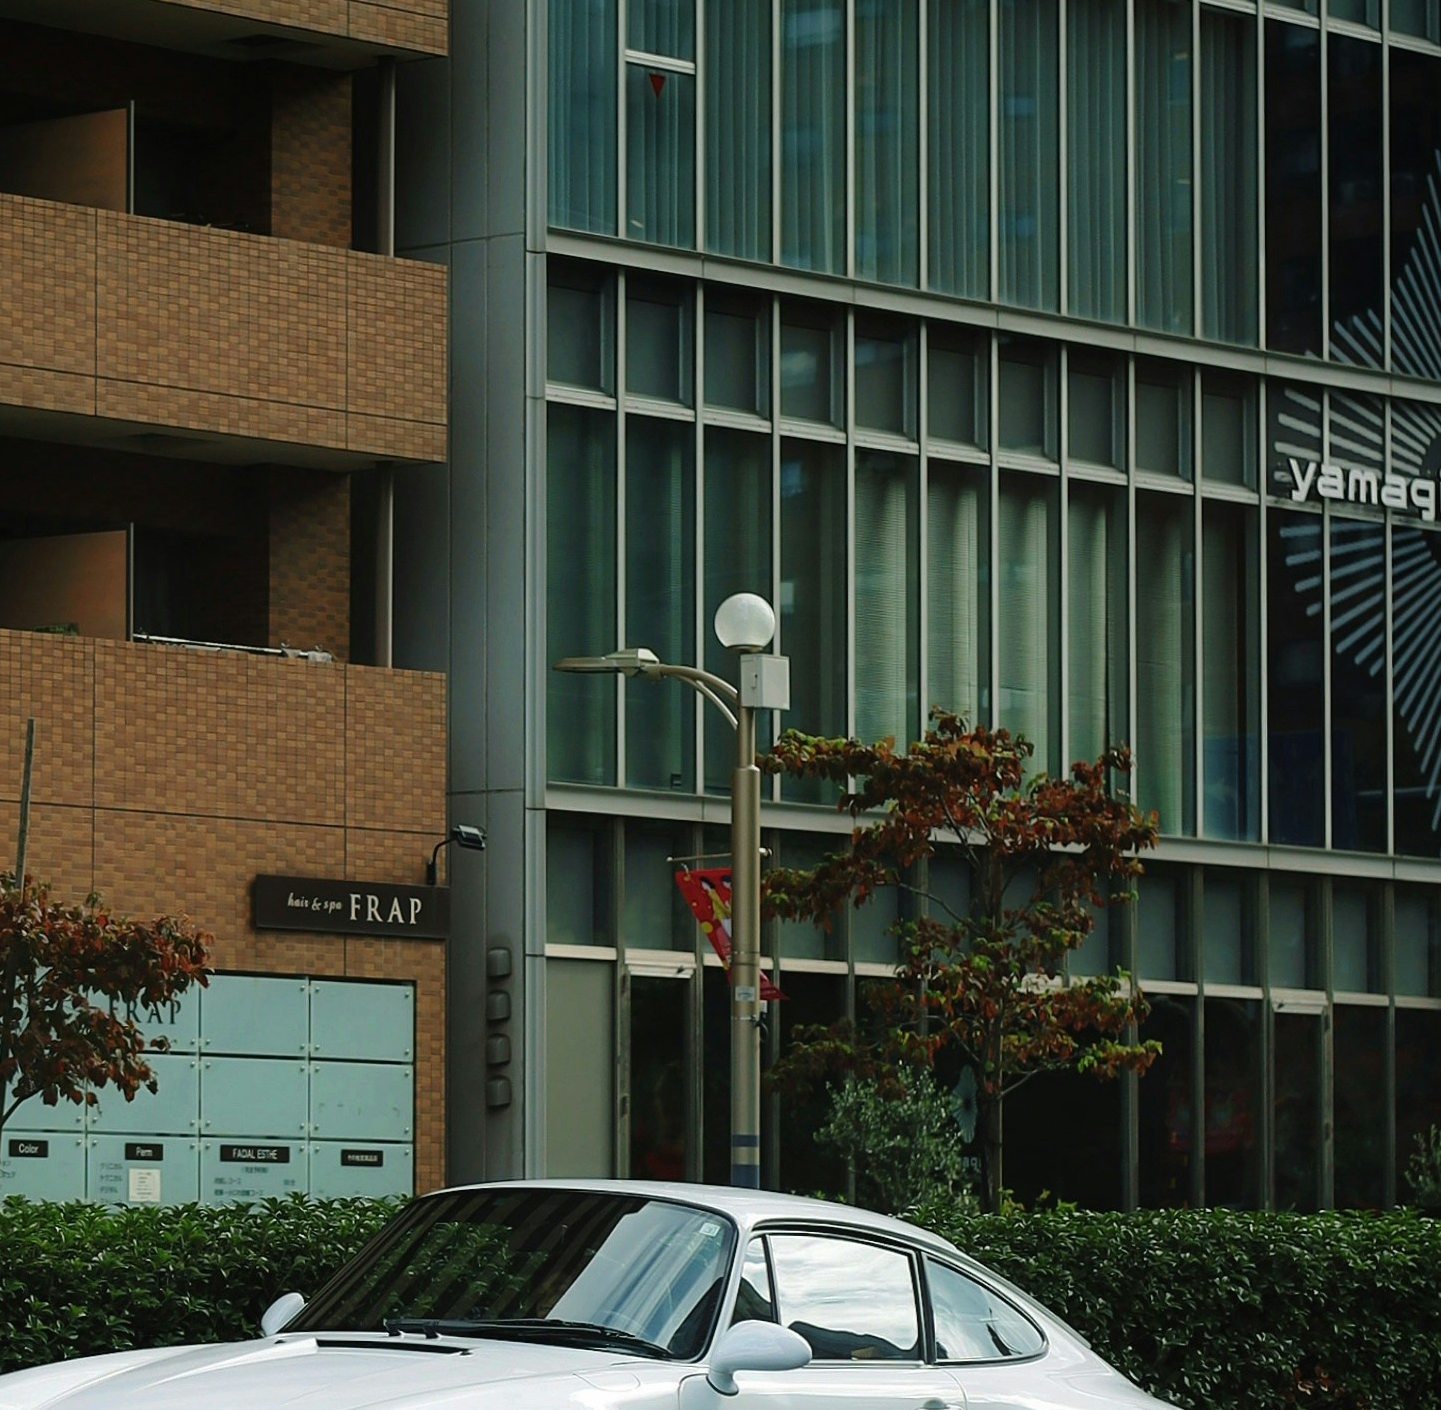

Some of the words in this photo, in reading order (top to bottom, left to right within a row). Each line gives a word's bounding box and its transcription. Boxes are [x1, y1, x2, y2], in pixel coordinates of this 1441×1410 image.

[286, 892, 309, 908] hair
[311, 897, 321, 911] &
[323, 899, 343, 914] spa
[349, 893, 423, 925] FRAP
[109, 996, 181, 1025] FRAP
[18, 1143, 39, 1154] Color
[135, 1146, 153, 1157] Perm
